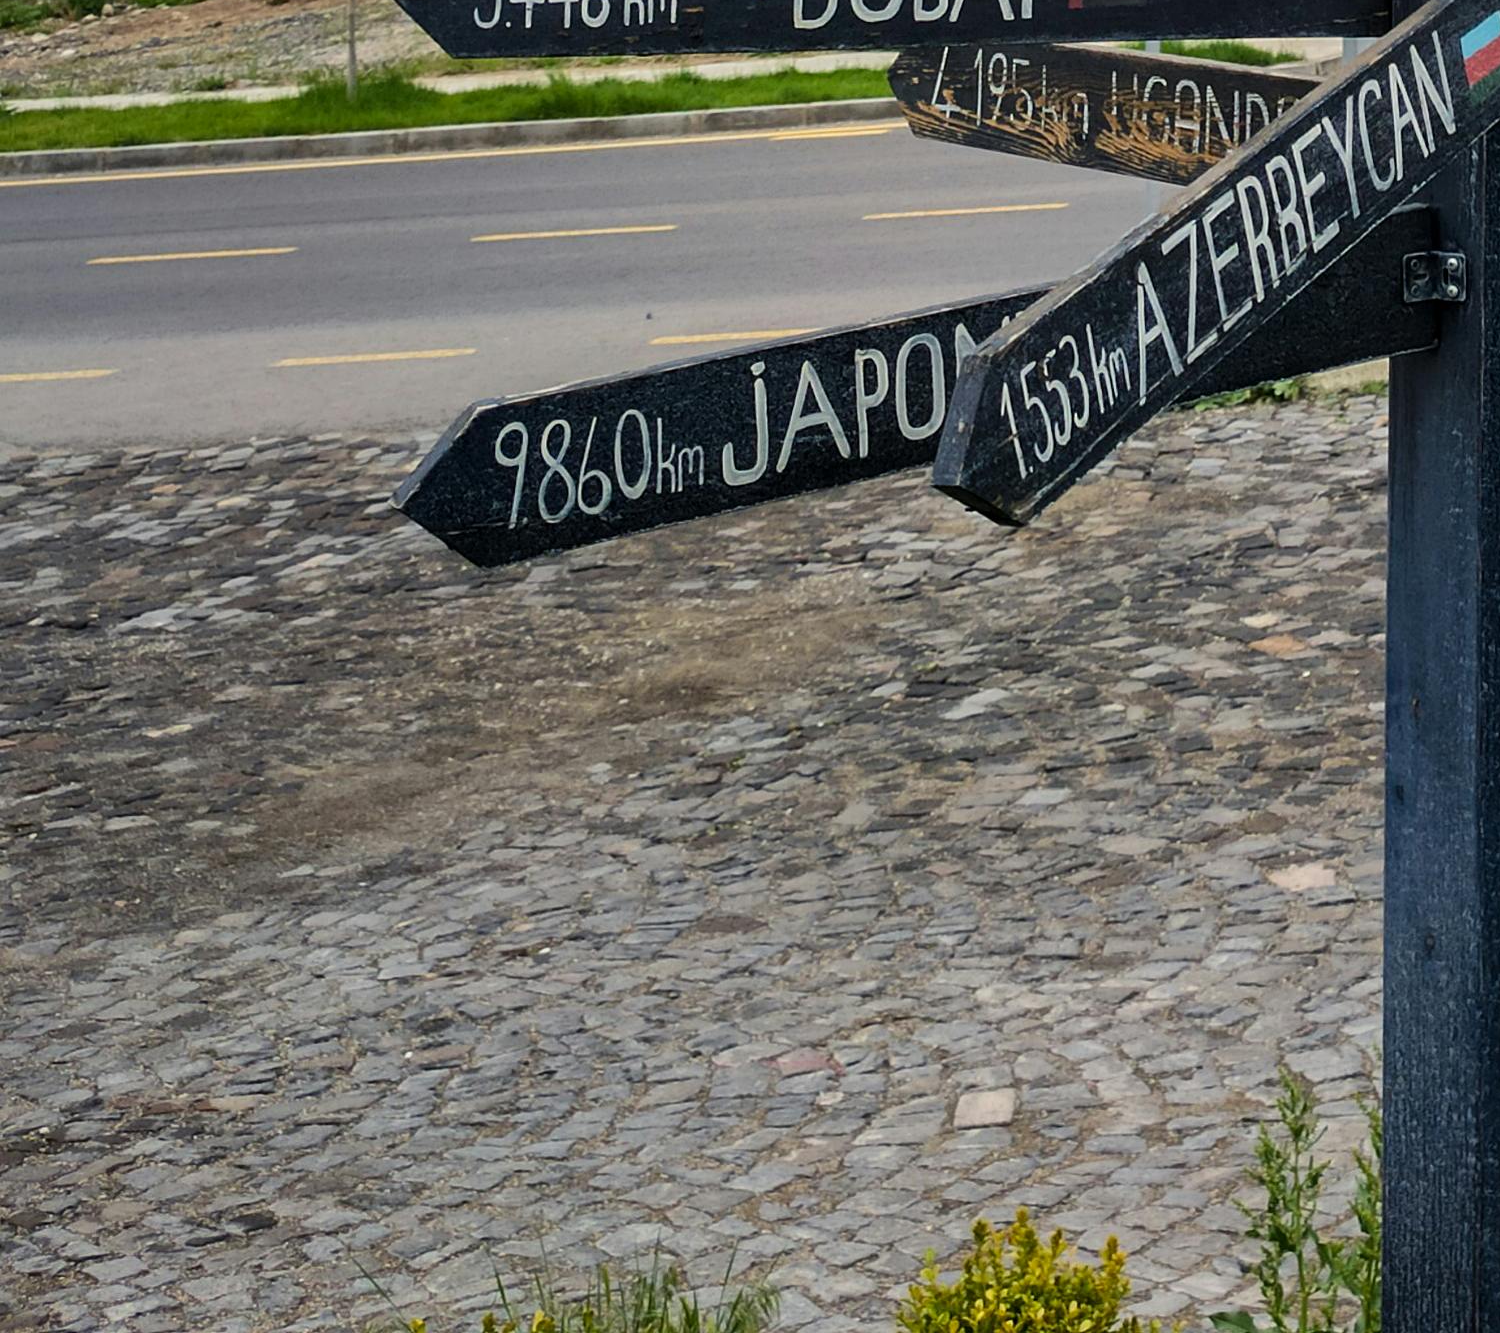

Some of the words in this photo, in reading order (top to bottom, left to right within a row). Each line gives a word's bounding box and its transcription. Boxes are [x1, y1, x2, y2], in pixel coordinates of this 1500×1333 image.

[494, 408, 652, 530] 9.860
[656, 417, 705, 494] km
[1001, 335, 1090, 480] 1.553
[1086, 323, 1131, 414] km
